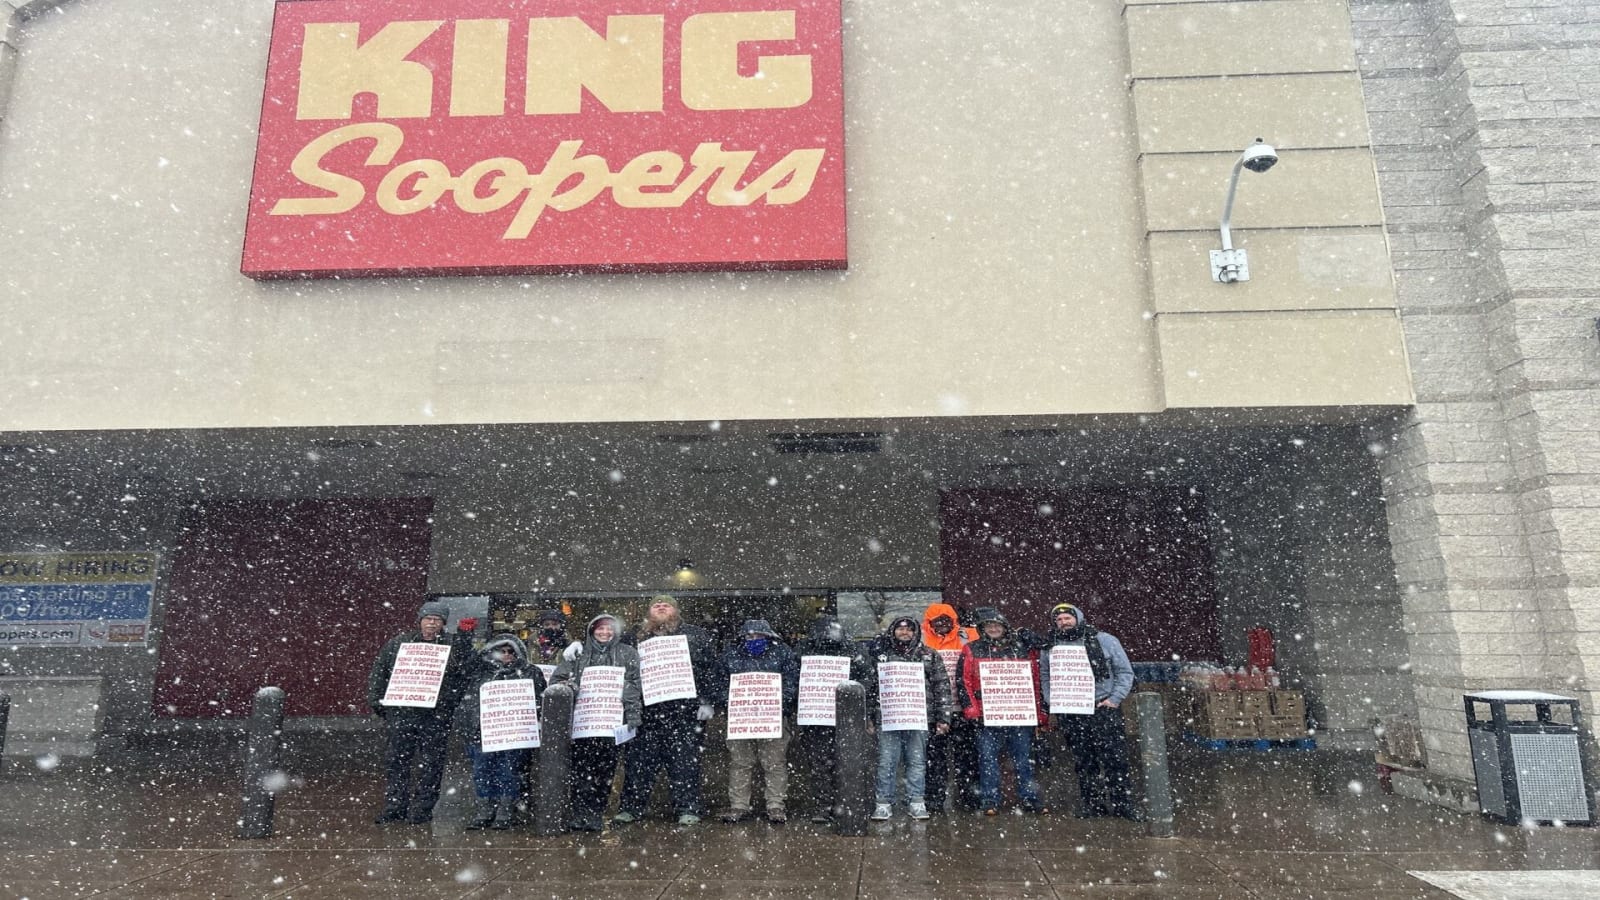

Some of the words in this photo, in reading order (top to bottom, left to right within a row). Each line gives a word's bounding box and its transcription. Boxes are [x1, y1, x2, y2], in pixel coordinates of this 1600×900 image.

[296, 11, 813, 120] KING
[270, 122, 826, 240] Soopers
[0, 561, 46, 576] OW
[56, 559, 149, 575] HIRING
[28, 588, 107, 602] starting
[114, 587, 136, 600] at
[641, 662, 690, 674] EMPLOYEES
[483, 709, 535, 718] EMPLOYEES
